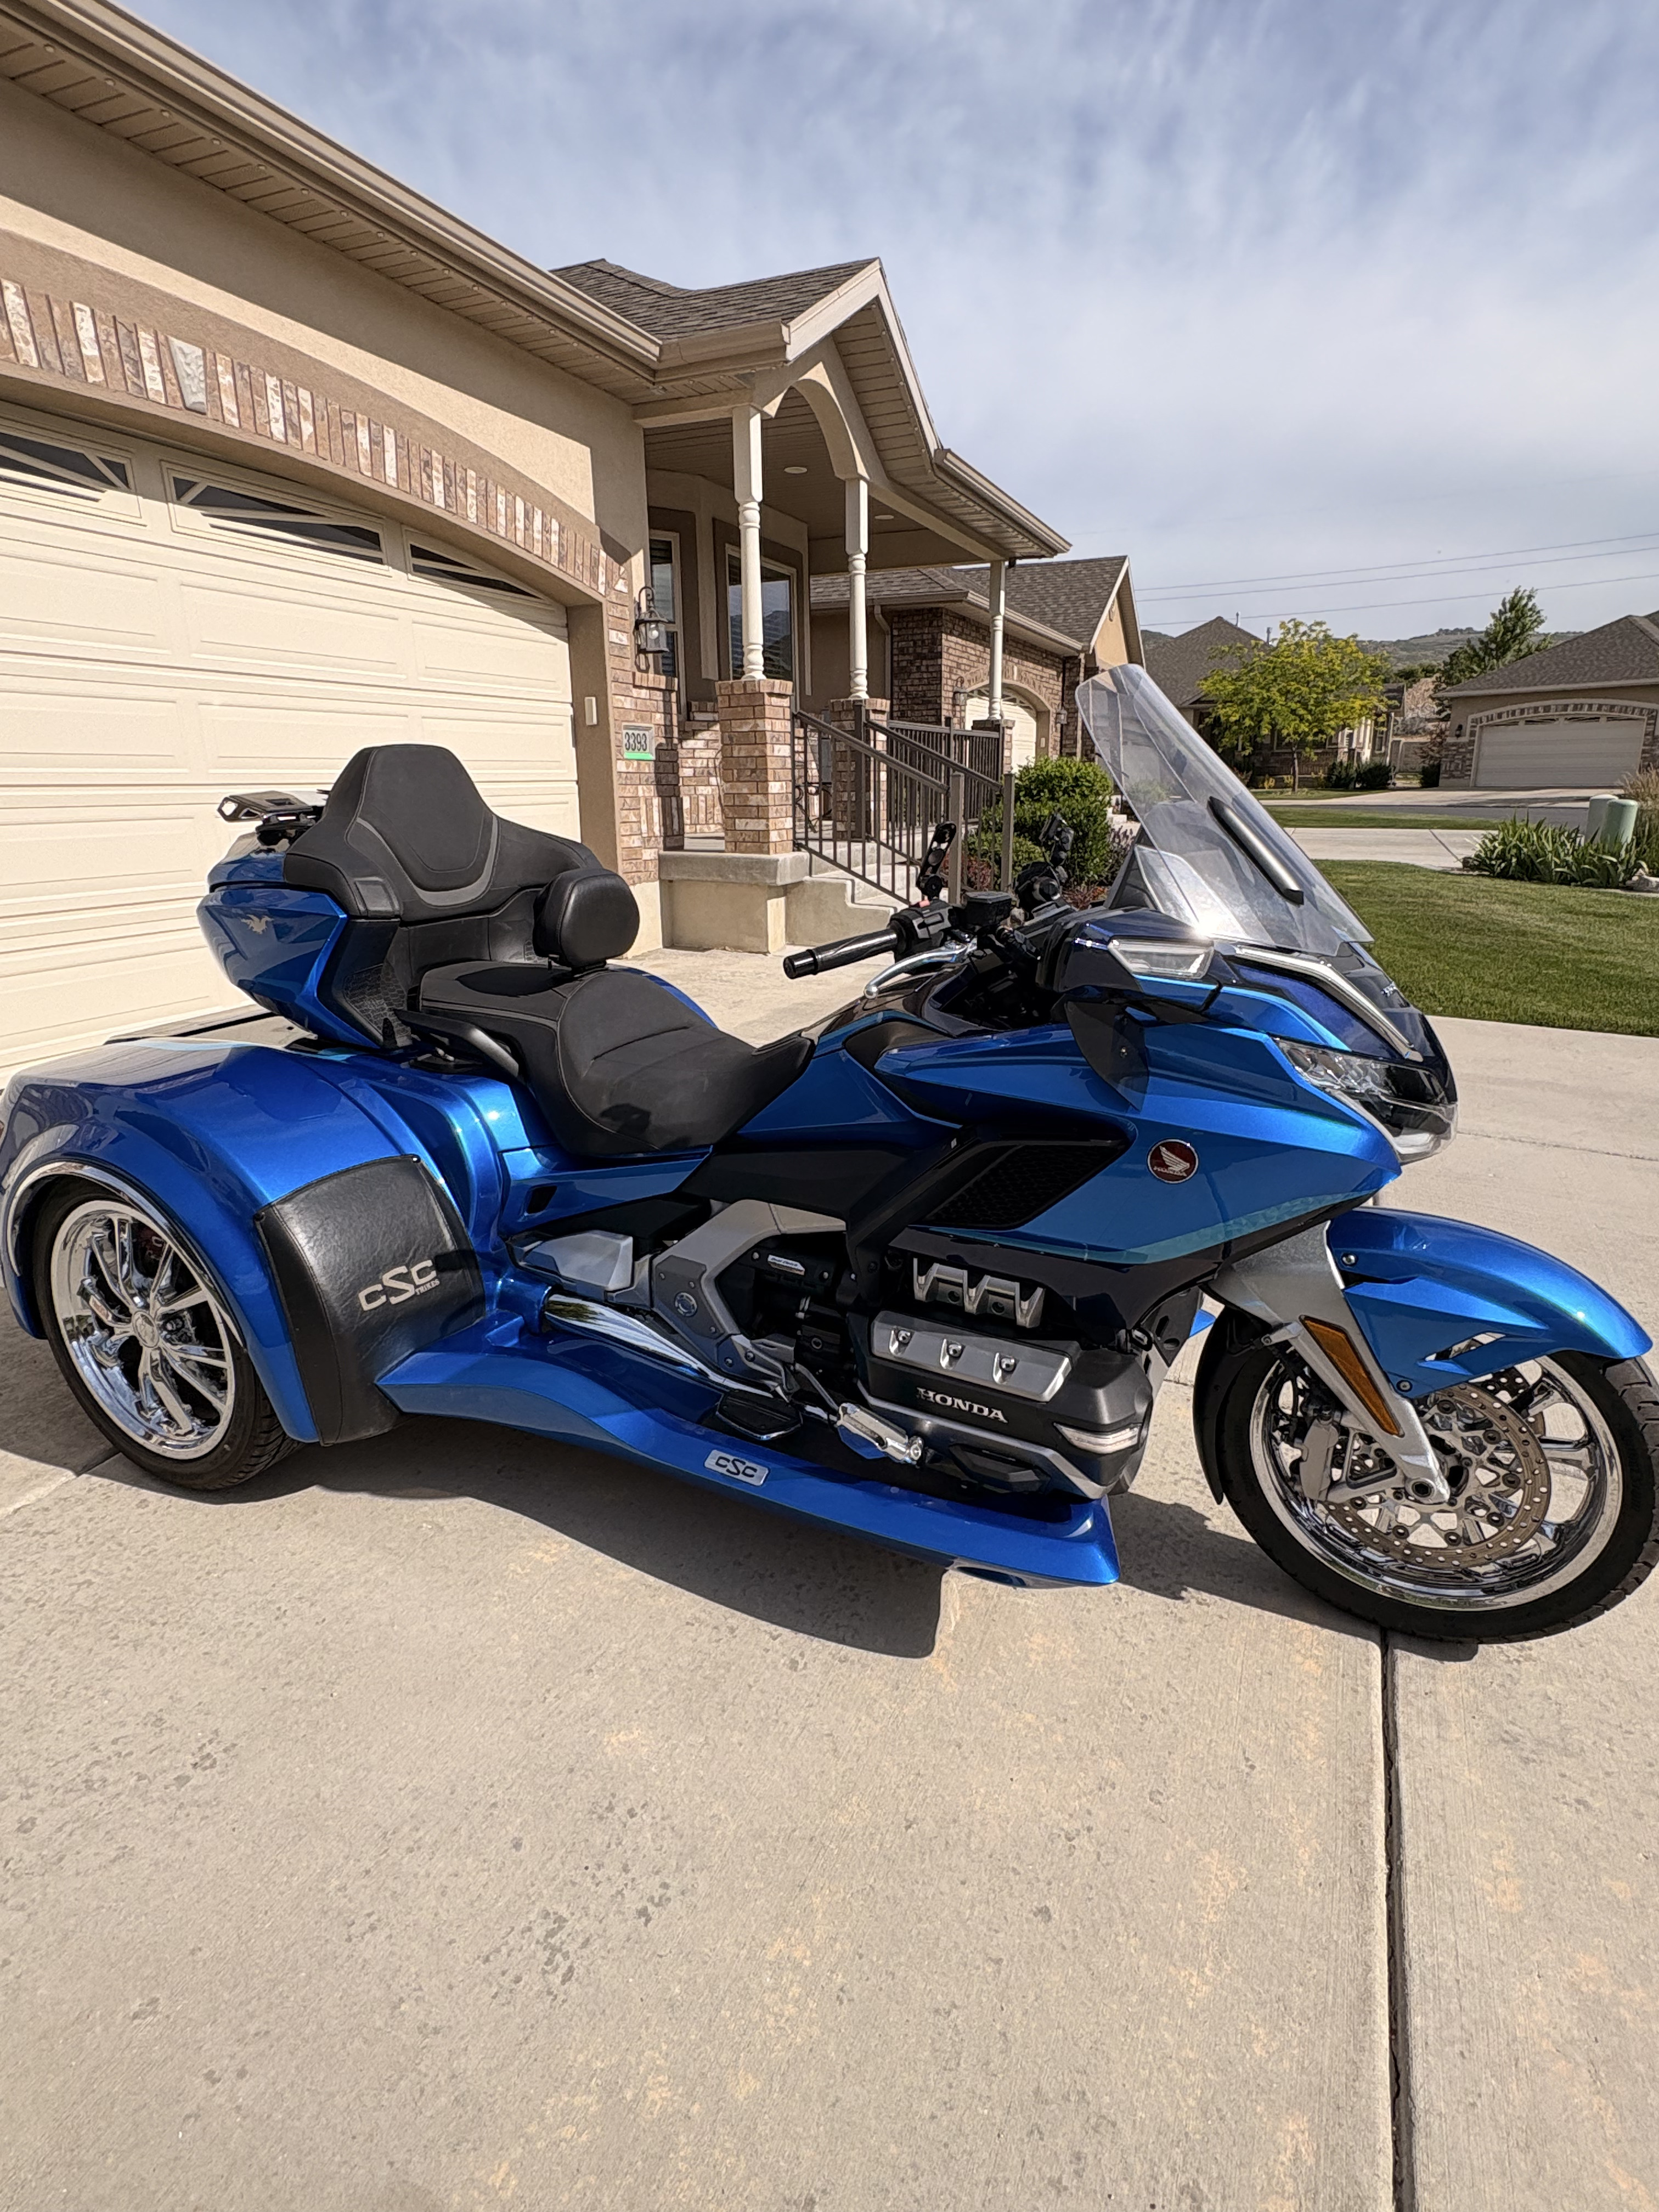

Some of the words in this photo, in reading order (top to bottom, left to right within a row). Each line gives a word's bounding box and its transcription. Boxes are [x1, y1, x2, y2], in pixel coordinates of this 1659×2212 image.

[624, 732, 647, 751] 3393
[358, 1260, 437, 1311] CSC
[916, 1387, 1008, 1423] HONDA
[715, 1456, 758, 1478] CSC
